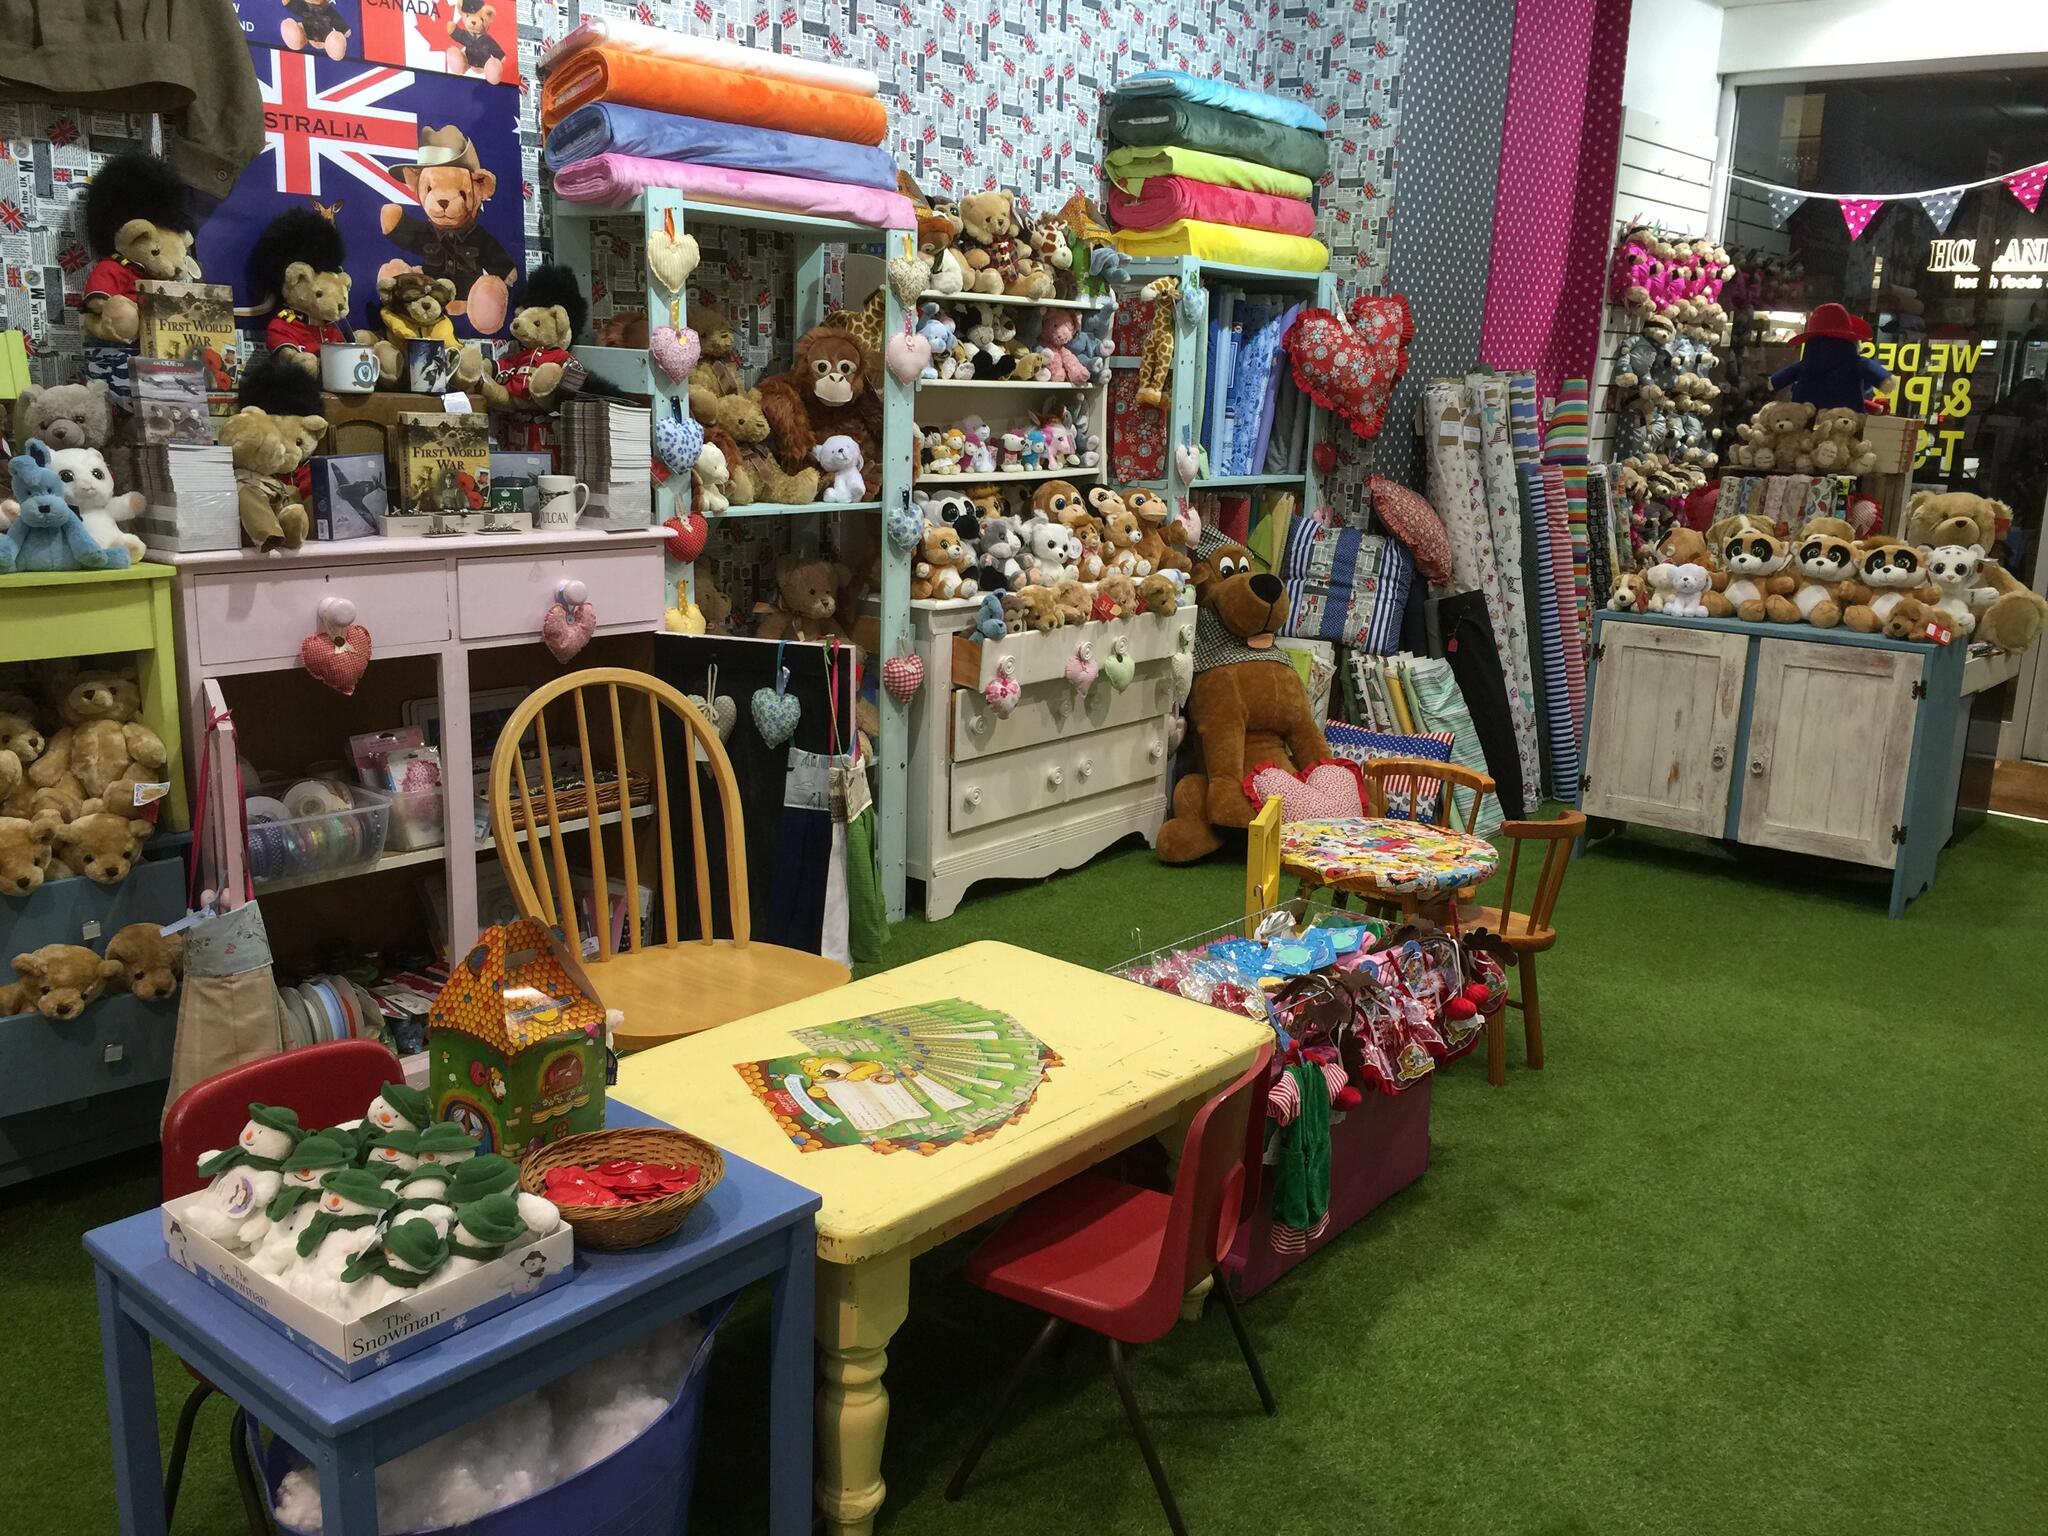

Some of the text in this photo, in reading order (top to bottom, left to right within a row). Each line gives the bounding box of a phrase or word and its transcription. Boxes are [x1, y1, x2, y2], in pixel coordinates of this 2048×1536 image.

[264, 112, 368, 140] STRALIA
[160, 319, 233, 334] FIRST WORLD
[182, 334, 212, 347] WAR
[413, 446, 487, 458] FIRST WORLD
[436, 459, 465, 470] WAR
[382, 1312, 412, 1330] The
[352, 1310, 441, 1357] Snowman
